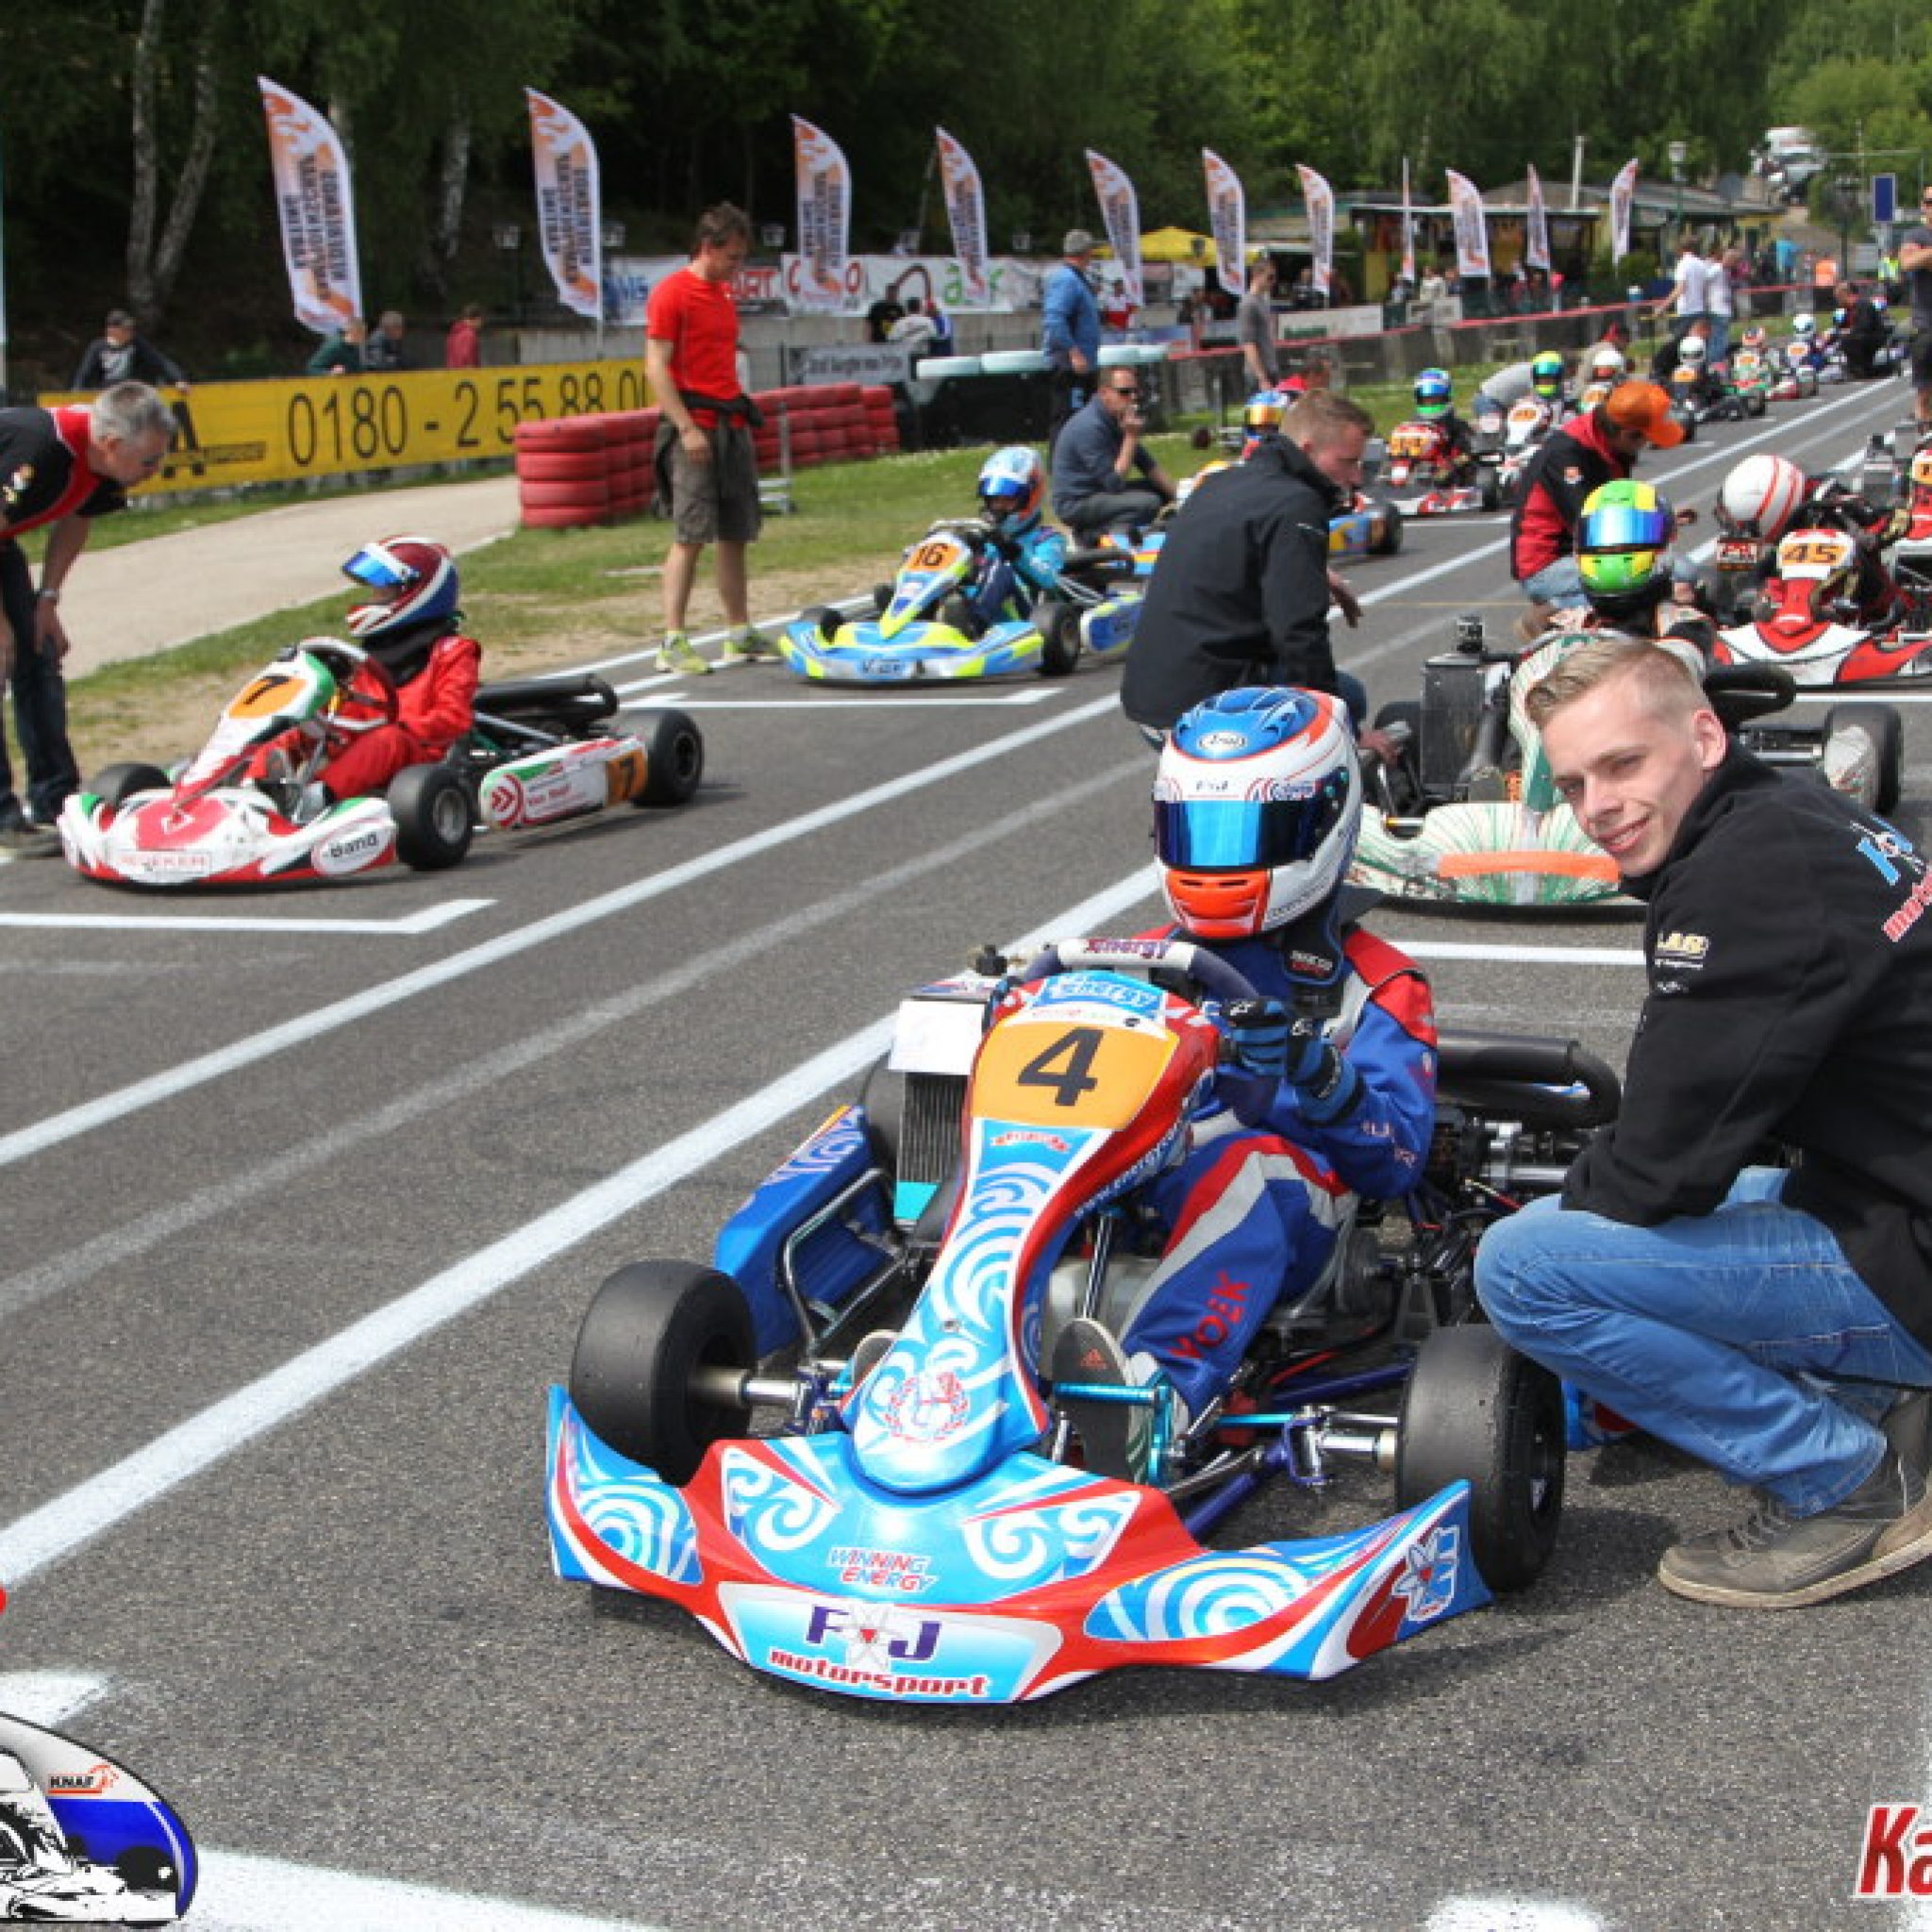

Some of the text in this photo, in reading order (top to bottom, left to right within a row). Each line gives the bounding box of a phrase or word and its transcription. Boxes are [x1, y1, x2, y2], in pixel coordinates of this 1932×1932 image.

[288, 385, 408, 467] 0180
[455, 380, 478, 448] 2
[914, 542, 949, 567] 16
[1782, 544, 1839, 564] 45
[243, 675, 290, 706] 7
[1017, 1026, 1104, 1106] 4
[829, 1548, 930, 1574] WINNING
[842, 1568, 938, 1591] ENERGY
[770, 1650, 987, 1695] motorsport
